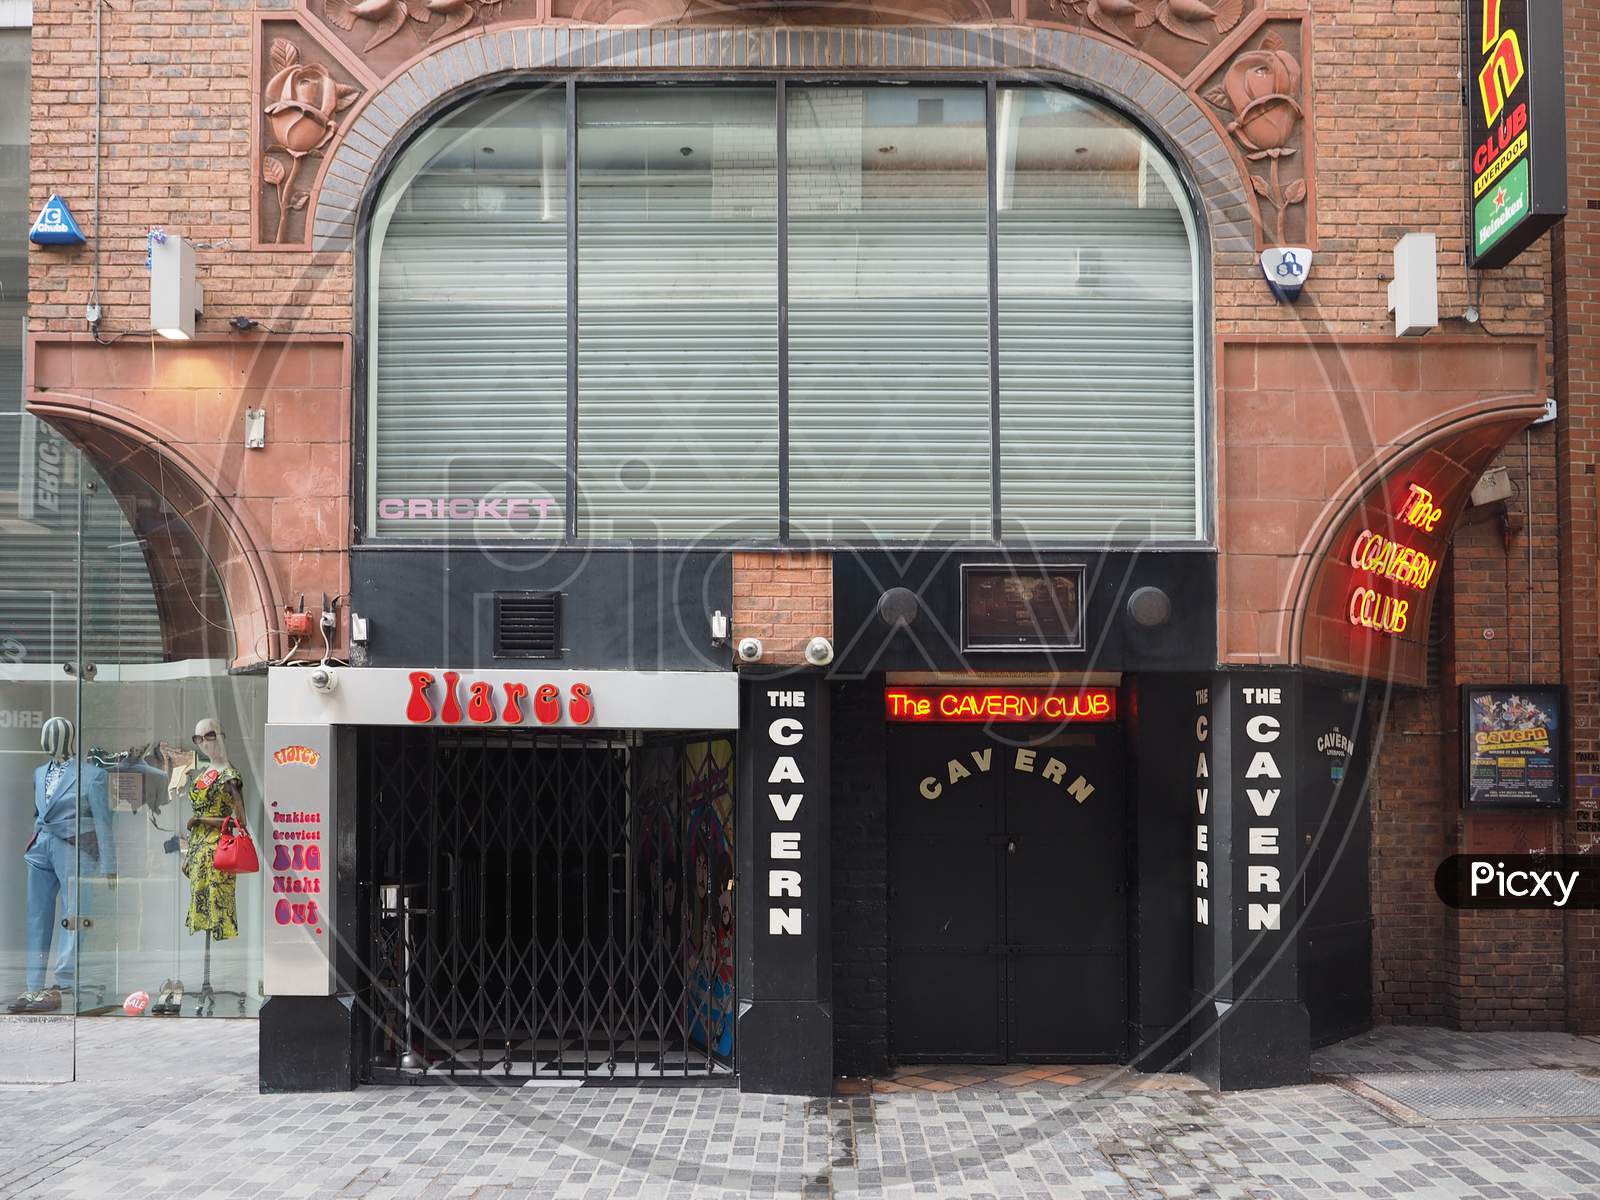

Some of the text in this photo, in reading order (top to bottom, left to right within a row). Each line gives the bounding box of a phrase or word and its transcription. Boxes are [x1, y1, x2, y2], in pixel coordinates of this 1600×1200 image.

[1474, 103, 1527, 174] CLUB
[1476, 140, 1525, 192] LIVERPOOL
[38, 223, 68, 232] Chubb
[1479, 192, 1523, 245] Heineken
[378, 498, 555, 519] CRICKET
[1401, 484, 1442, 532] The
[1355, 532, 1437, 589] CAVERN
[1354, 588, 1409, 633] CLUB
[767, 691, 805, 707] THE
[888, 694, 1110, 717] The CAVERN CLUB
[1195, 689, 1208, 704] THE
[1242, 688, 1281, 704] THE
[1317, 732, 1354, 756] CAVERN
[919, 748, 1095, 803] CAVERN
[273, 811, 320, 823] Funkiest
[767, 717, 805, 936] CAVERN
[1196, 715, 1209, 926] CAVERN
[1244, 715, 1282, 930] CAVERN
[273, 830, 320, 840] Grooviest
[273, 844, 321, 871] BIG
[272, 876, 320, 893] Night
